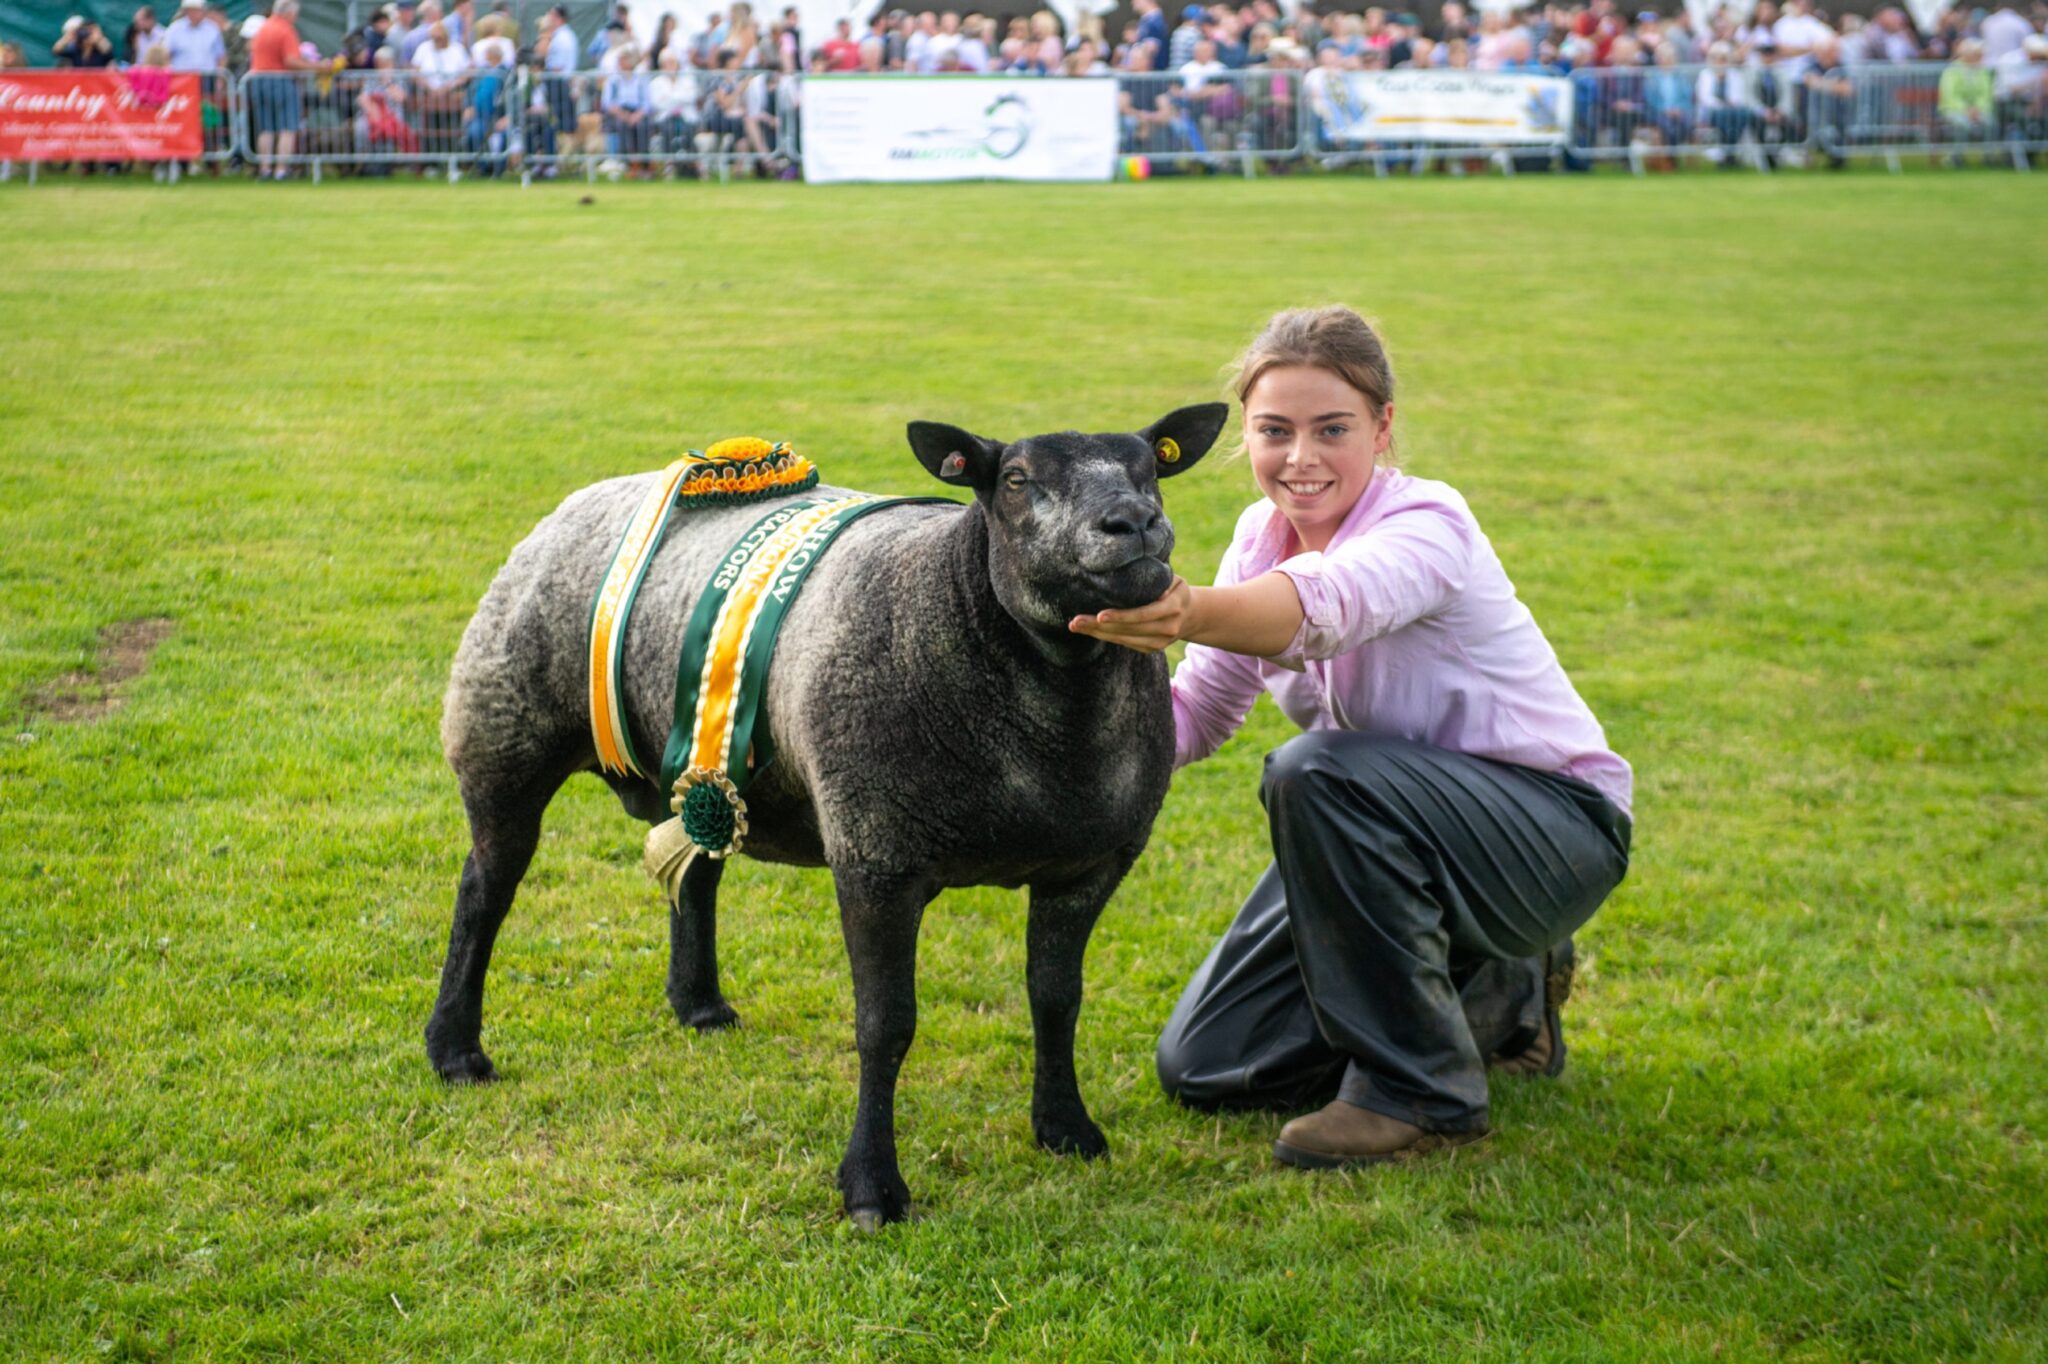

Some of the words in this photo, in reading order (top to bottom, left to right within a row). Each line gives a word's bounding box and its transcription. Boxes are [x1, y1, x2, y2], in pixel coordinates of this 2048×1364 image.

[712, 507, 801, 590] TRACTORS
[744, 499, 846, 596] AMPIONS
[772, 520, 840, 603] SHOW
